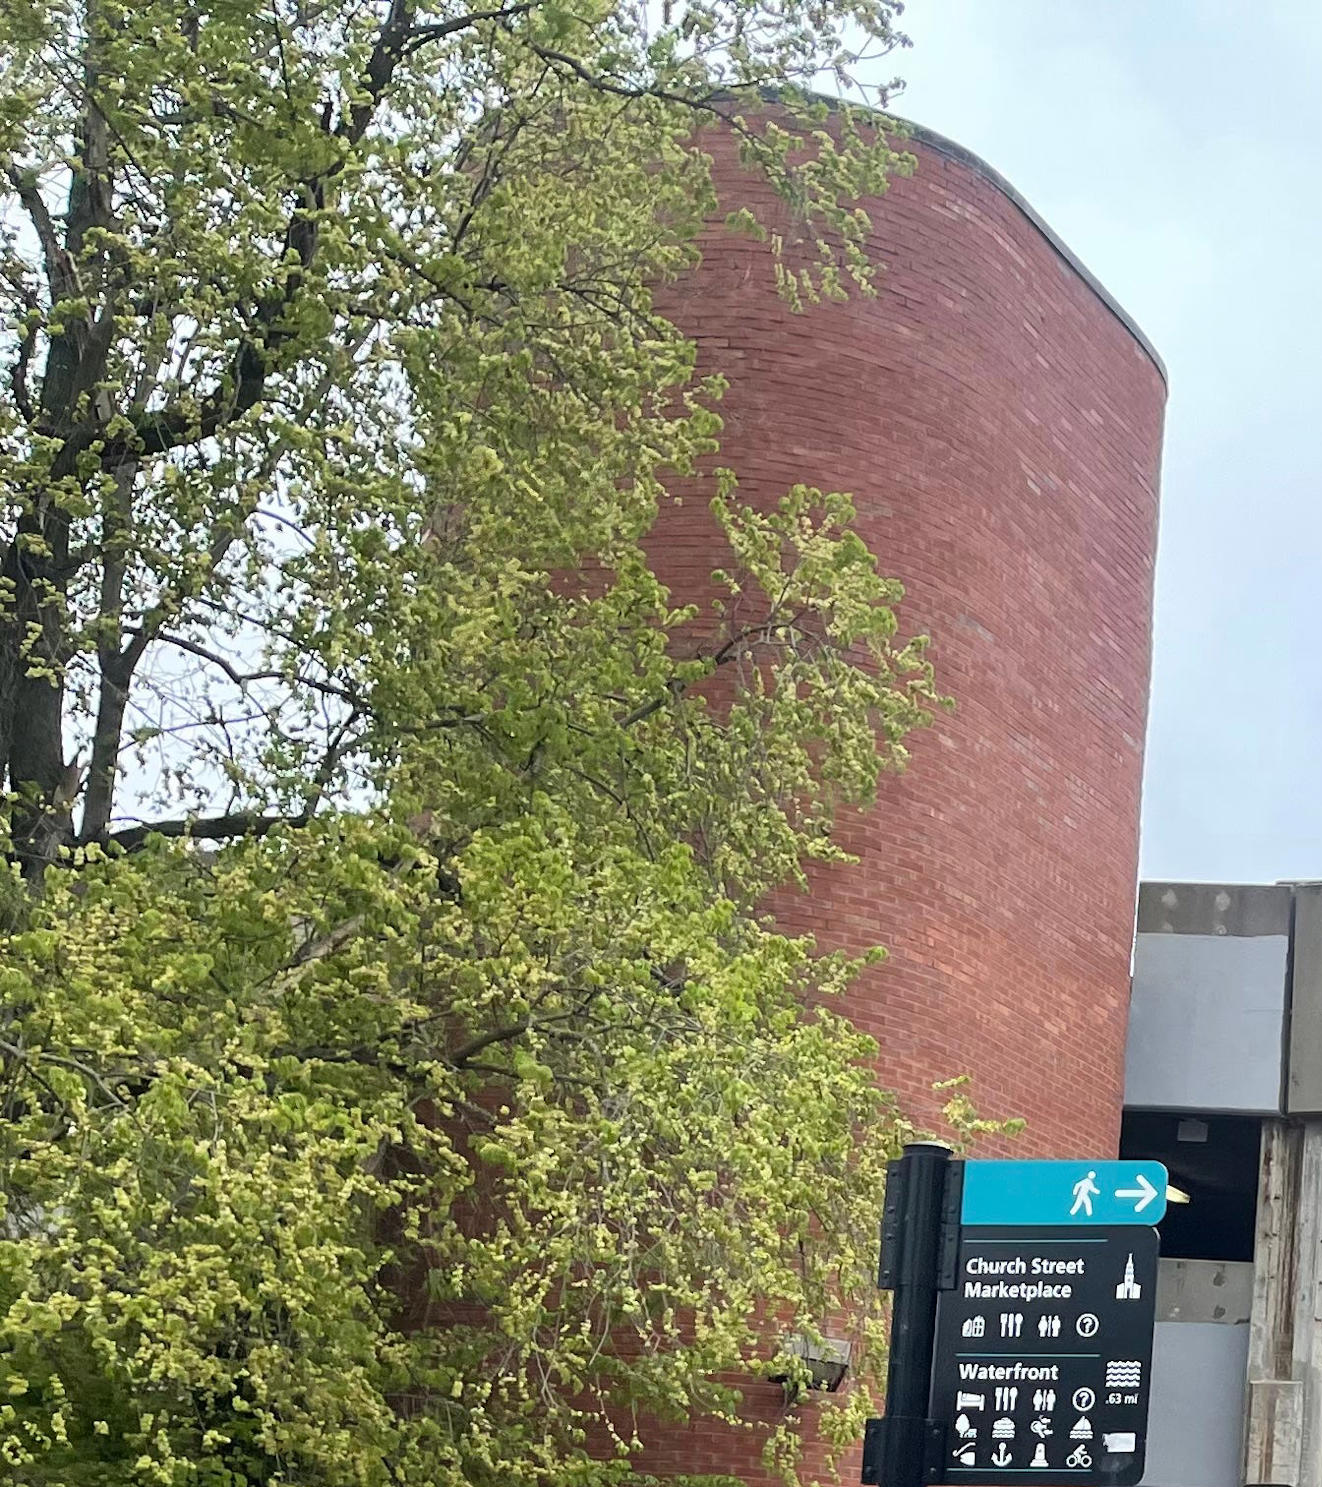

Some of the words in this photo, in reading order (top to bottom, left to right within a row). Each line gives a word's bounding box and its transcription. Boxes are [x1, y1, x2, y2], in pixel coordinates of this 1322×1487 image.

[965, 1256, 1027, 1275] Church
[1030, 1257, 1085, 1275] Street
[964, 1280, 1073, 1302] Marketplace
[959, 1362, 1060, 1381] Waterfront
[1105, 1392, 1122, 1405] .63
[1124, 1393, 1139, 1405] mi
